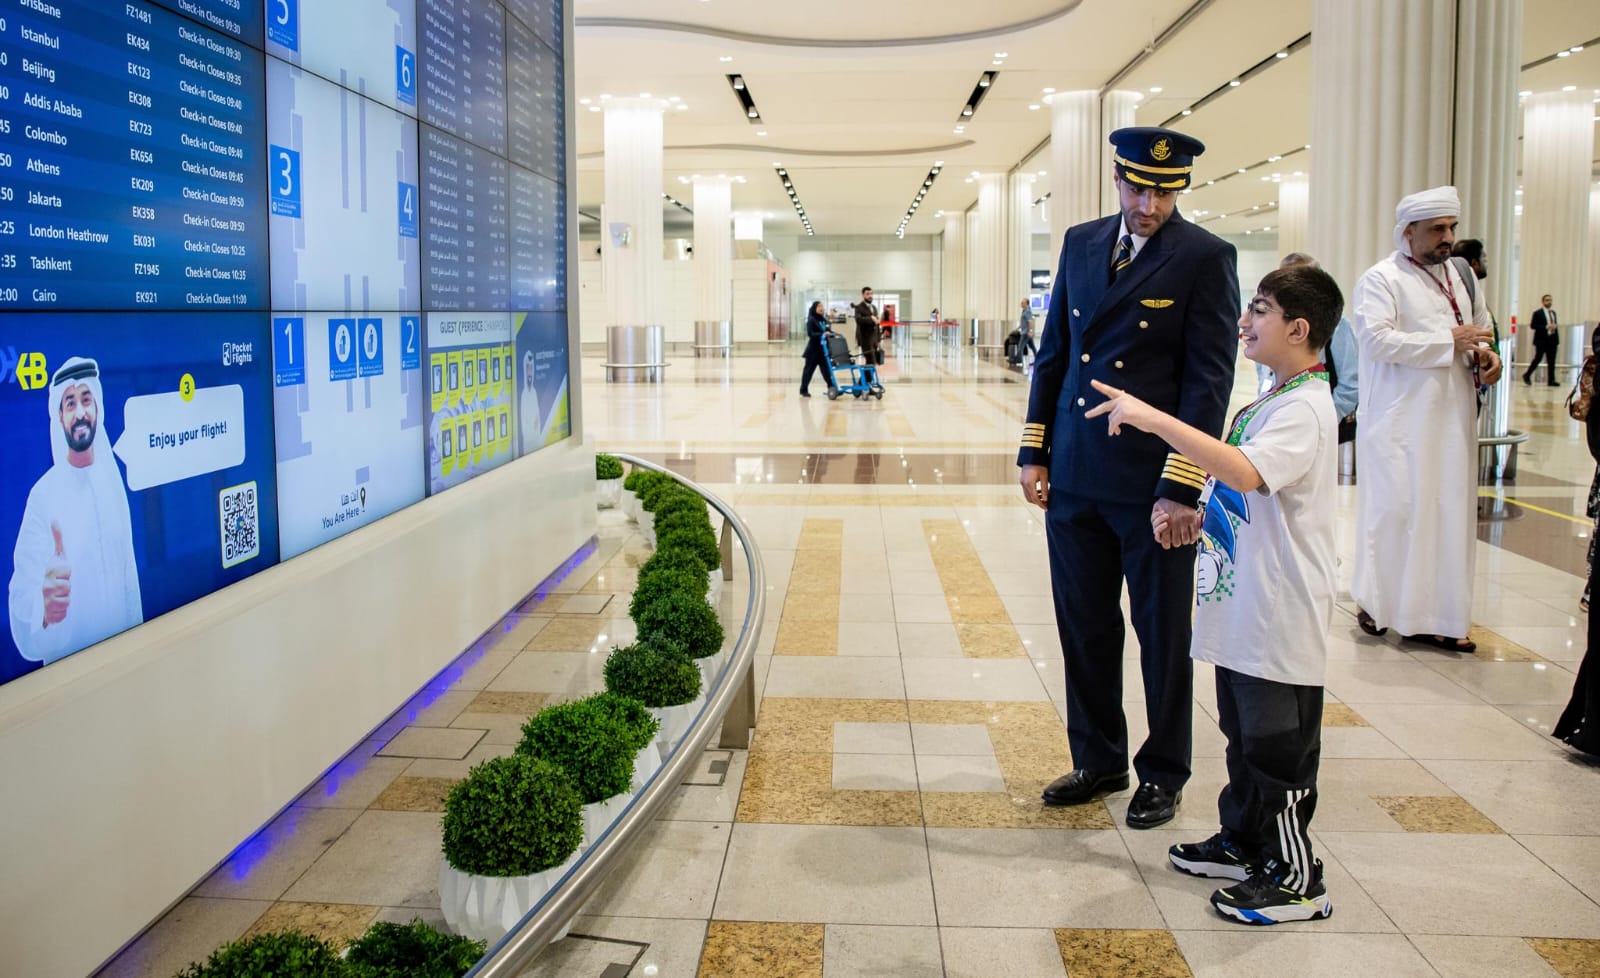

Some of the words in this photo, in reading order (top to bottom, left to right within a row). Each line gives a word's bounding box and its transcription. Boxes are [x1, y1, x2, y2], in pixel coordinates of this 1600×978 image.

[126, 4, 151, 24] FZ1481
[179, 27, 205, 46] Check-in
[207, 39, 225, 54] Closes
[226, 47, 241, 61] 09:30
[178, 0, 205, 18] Check-in
[206, 11, 224, 27] Closes
[226, 20, 240, 34] 09:30
[22, 26, 59, 49] Istanbul
[128, 62, 150, 79] EK123
[180, 80, 206, 98] Check-in
[208, 90, 226, 104] Closes
[227, 96, 242, 110] 09:40
[127, 33, 150, 50] EK434
[179, 54, 206, 72] Check-in
[207, 64, 225, 80] Closes
[226, 72, 241, 85] 09:35
[402, 54, 410, 87] 6
[23, 59, 55, 82] Beijing
[129, 91, 151, 108] EK308
[181, 108, 206, 124] Check-in
[208, 116, 226, 130] Closes
[228, 122, 242, 134] 09:40
[24, 92, 50, 110] Addis
[54, 100, 82, 118] Ababa
[130, 120, 152, 135] EK723
[181, 134, 207, 150] Check-in
[209, 141, 227, 154] Closes
[228, 146, 242, 158] 09:40
[26, 126, 67, 145] Colombo
[131, 149, 153, 163] EK654
[182, 161, 208, 175] Check-in
[210, 167, 227, 180] Closes
[229, 171, 243, 183] 09:45
[27, 158, 60, 175] Athens
[132, 178, 153, 192] EK209
[183, 187, 209, 201] Check-in
[210, 192, 228, 204] Closes
[229, 196, 244, 207] 09:50
[280, 152, 291, 195] 3
[28, 192, 61, 207] Jakarta
[133, 206, 154, 220] EK358
[184, 214, 209, 226] Check-in
[211, 218, 229, 229] Closes
[230, 220, 244, 232] 09:50
[404, 188, 412, 220] 4
[30, 224, 64, 238] London
[67, 228, 108, 242] Heathrow
[134, 235, 155, 247] EK031
[184, 240, 210, 252] Check-in
[212, 243, 230, 254] Closes
[231, 246, 245, 256] 10:25
[30, 256, 72, 270] Tashkent
[135, 264, 159, 275] FZ1945
[186, 267, 211, 278] Check-in
[212, 268, 230, 279] Closes
[232, 270, 246, 280] 10:35
[33, 289, 56, 301] Cairo
[136, 292, 157, 302] EK921
[186, 293, 212, 303] Check-in
[213, 294, 231, 304] Closes
[233, 294, 247, 304] 11:00
[232, 343, 252, 352] Pocket
[285, 323, 292, 364] 1
[407, 320, 414, 353] 2
[232, 352, 252, 365] Flights
[185, 382, 190, 394] 3
[150, 432, 175, 449] Enjoy
[179, 430, 198, 445] your
[201, 421, 226, 439] flight!
[322, 517, 333, 528] You
[335, 513, 344, 524] Are
[346, 508, 359, 519] Here
